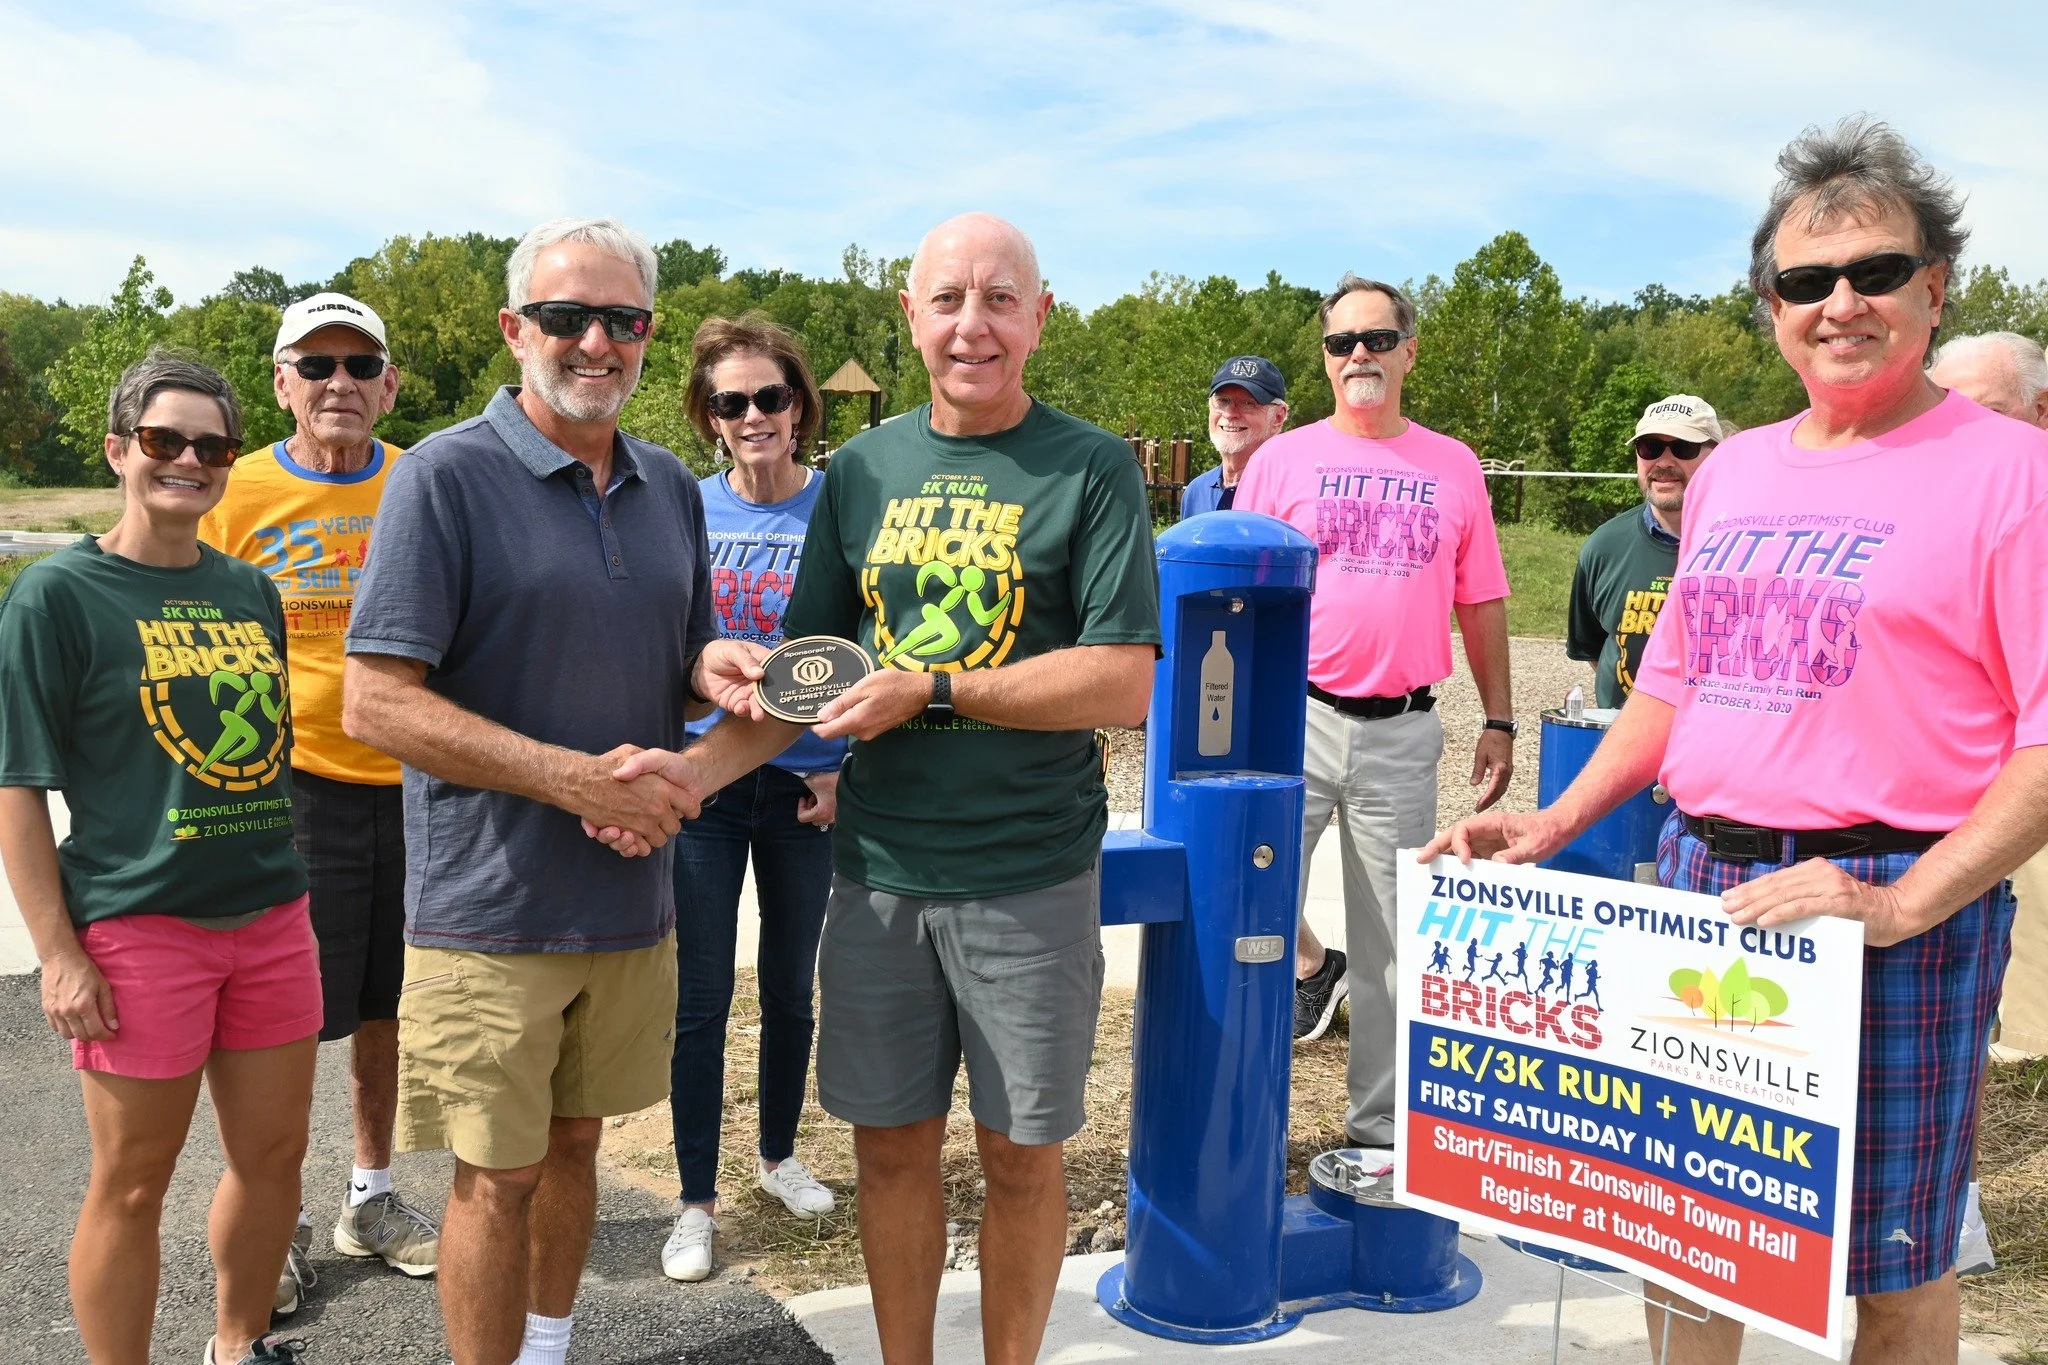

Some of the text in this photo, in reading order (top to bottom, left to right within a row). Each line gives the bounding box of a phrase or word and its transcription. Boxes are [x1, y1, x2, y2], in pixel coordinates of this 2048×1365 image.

[308, 304, 364, 316] PURDUE
[1649, 403, 1693, 417] PURDUE
[1324, 466, 1439, 481] ZIONSVILLE OPTIMIST CLUB
[920, 481, 988, 497] 5K RUN
[1319, 475, 1437, 506] HIT THE
[321, 515, 373, 535] YEAR
[883, 497, 1023, 535] HIT THE
[1717, 514, 1896, 535] ZIONSVILLE OPTIMIST CLUB
[707, 532, 806, 542] ZIONSVILLE OPTIMIS
[1316, 499, 1440, 563] BRICKS
[256, 520, 324, 575] 35
[710, 542, 800, 572] HIT TH
[870, 527, 1017, 571] BRICKS
[1685, 530, 1886, 581] HIT THE
[296, 567, 340, 589] Still
[1340, 565, 1381, 574] OCTOBER
[1650, 581, 1666, 590] 5K
[1625, 591, 1667, 611] HIT
[162, 607, 223, 619] 5K RUN
[135, 620, 270, 647] HIT THE
[307, 630, 337, 638] CLASSIC
[742, 633, 782, 642] OCTOBE
[1679, 575, 1866, 687] BRICKS
[144, 643, 282, 680] BRICKS
[783, 647, 825, 659] Sponsored
[779, 681, 852, 697] THE ZIONSVILLE
[779, 691, 825, 704] OPTIMIST
[1205, 682, 1229, 691] Filtered
[1700, 677, 1720, 688] Race
[1722, 681, 1740, 691] and
[1742, 683, 1773, 696] Family
[1776, 685, 1792, 696] Fun
[1795, 688, 1822, 700] Run
[797, 704, 814, 712] May
[1207, 694, 1226, 702] Water
[1699, 692, 1751, 709] OCTOBER
[1766, 701, 1792, 714] 2020
[180, 803, 243, 820] ZIONSVILLE
[245, 798, 283, 812] OPTIMIST
[204, 818, 273, 837] ZIONSVILLE
[1431, 874, 1817, 964] ZIONSVILLE OPTIMIST CLUB
[1416, 901, 1604, 965] HIT THE
[1421, 973, 1603, 1050] BRICKS
[1630, 1027, 1820, 1098] ZIONSVILLE
[1650, 1058, 1796, 1106] PARKS & RECREATION
[1428, 1035, 1813, 1169] 5K/3K RUN + WALK
[1420, 1080, 1820, 1219] FIRST SATURDAY IN OCTOBER
[1433, 1125, 1797, 1262] Start/Finish Zionsville Town Hall
[1480, 1175, 1737, 1284] Register at tuxbro.com
